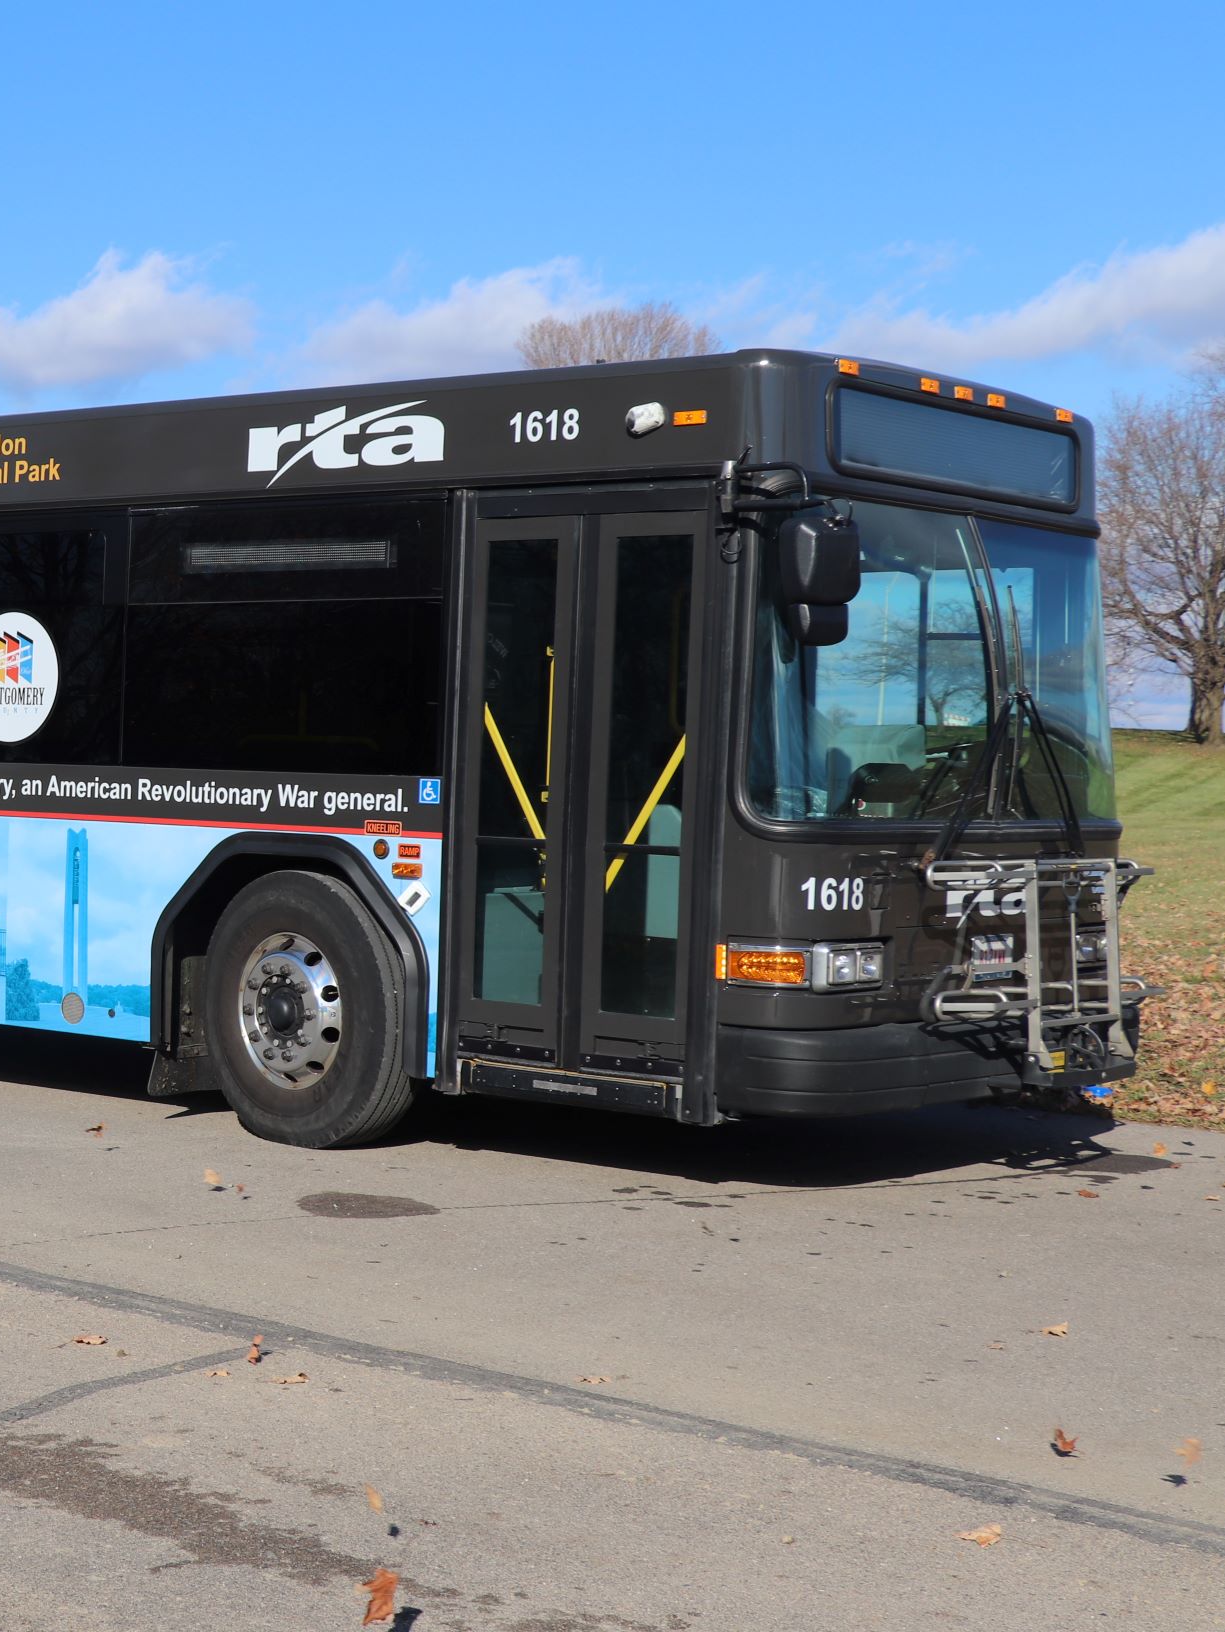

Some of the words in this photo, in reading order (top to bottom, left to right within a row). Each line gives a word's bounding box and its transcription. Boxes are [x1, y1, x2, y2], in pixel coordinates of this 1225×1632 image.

[510, 408, 580, 443] 1618
[247, 400, 444, 488] rta
[14, 459, 61, 482] Park
[21, 779, 42, 796] an
[46, 774, 132, 800] American
[137, 778, 273, 812] Revolutionary
[277, 783, 319, 808] War
[323, 788, 408, 815] general.
[367, 823, 399, 835] KNEELING
[399, 845, 419, 856] RAMP
[800, 877, 864, 911] 1618
